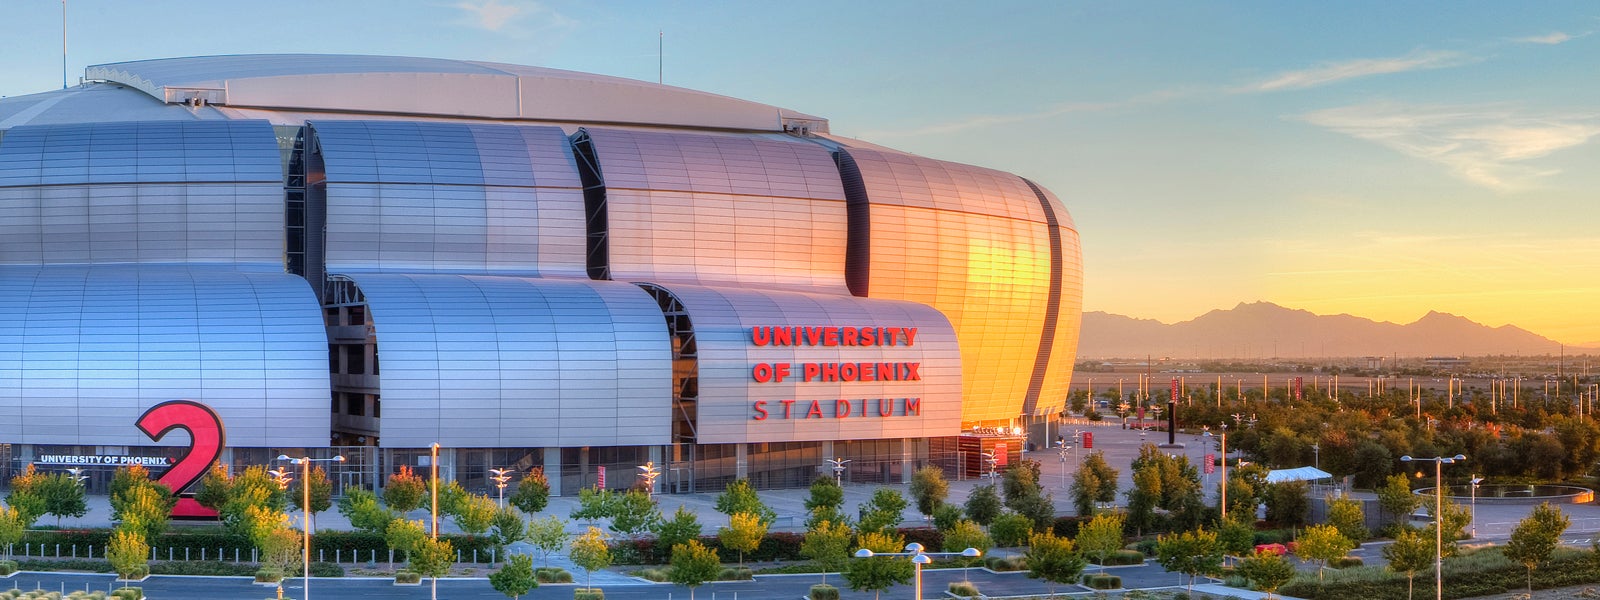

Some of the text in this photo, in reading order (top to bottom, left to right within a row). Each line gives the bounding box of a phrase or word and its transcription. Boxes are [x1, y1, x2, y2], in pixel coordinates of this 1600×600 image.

[752, 326, 918, 347] UNIVERSITY
[753, 362, 922, 383] OF PHOENIX
[753, 398, 921, 421] STADIUM
[40, 454, 167, 465] UNIVERSITY OF PHOENIX
[135, 399, 226, 521] 2
